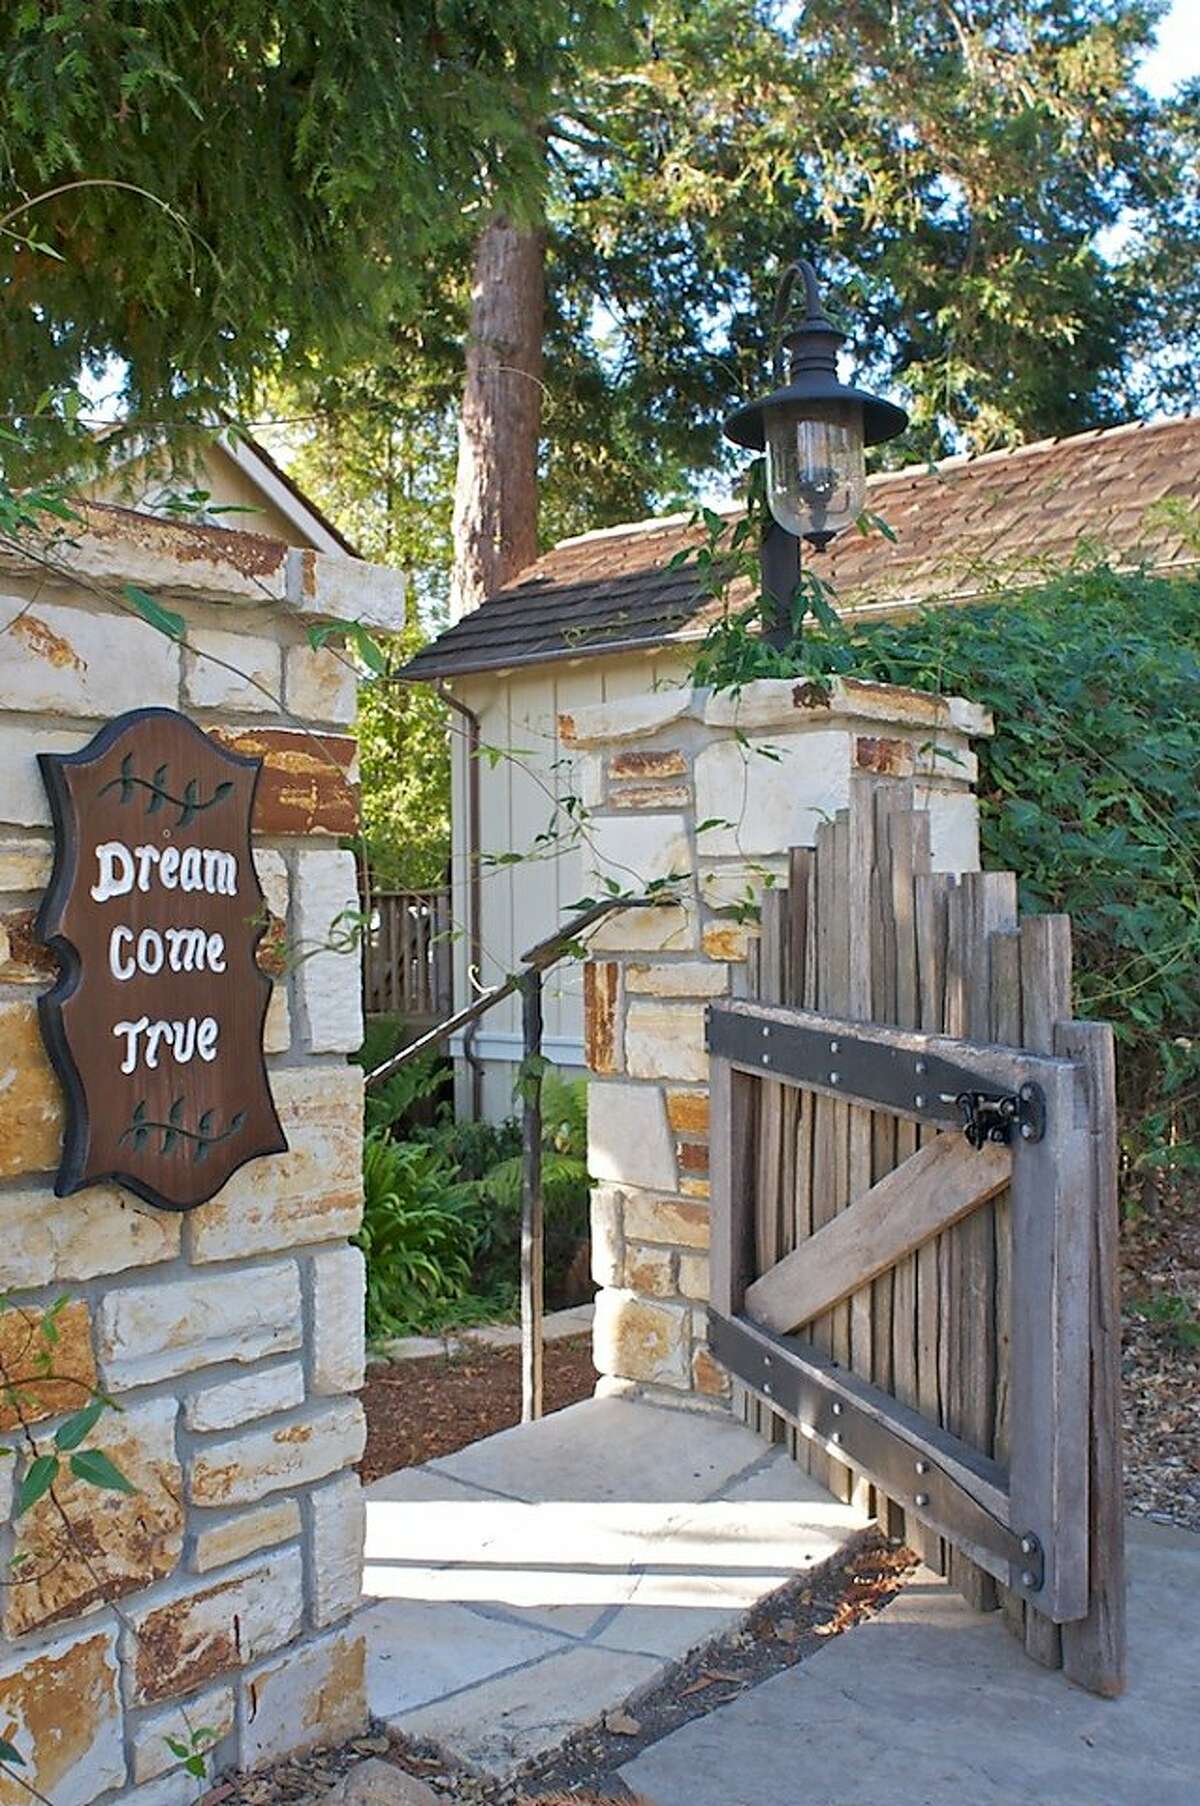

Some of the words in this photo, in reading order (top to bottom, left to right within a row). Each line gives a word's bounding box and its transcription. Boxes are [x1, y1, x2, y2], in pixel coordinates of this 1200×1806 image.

[90, 840, 237, 902] Dream
[108, 924, 226, 981] Come
[113, 1016, 218, 1075] True
